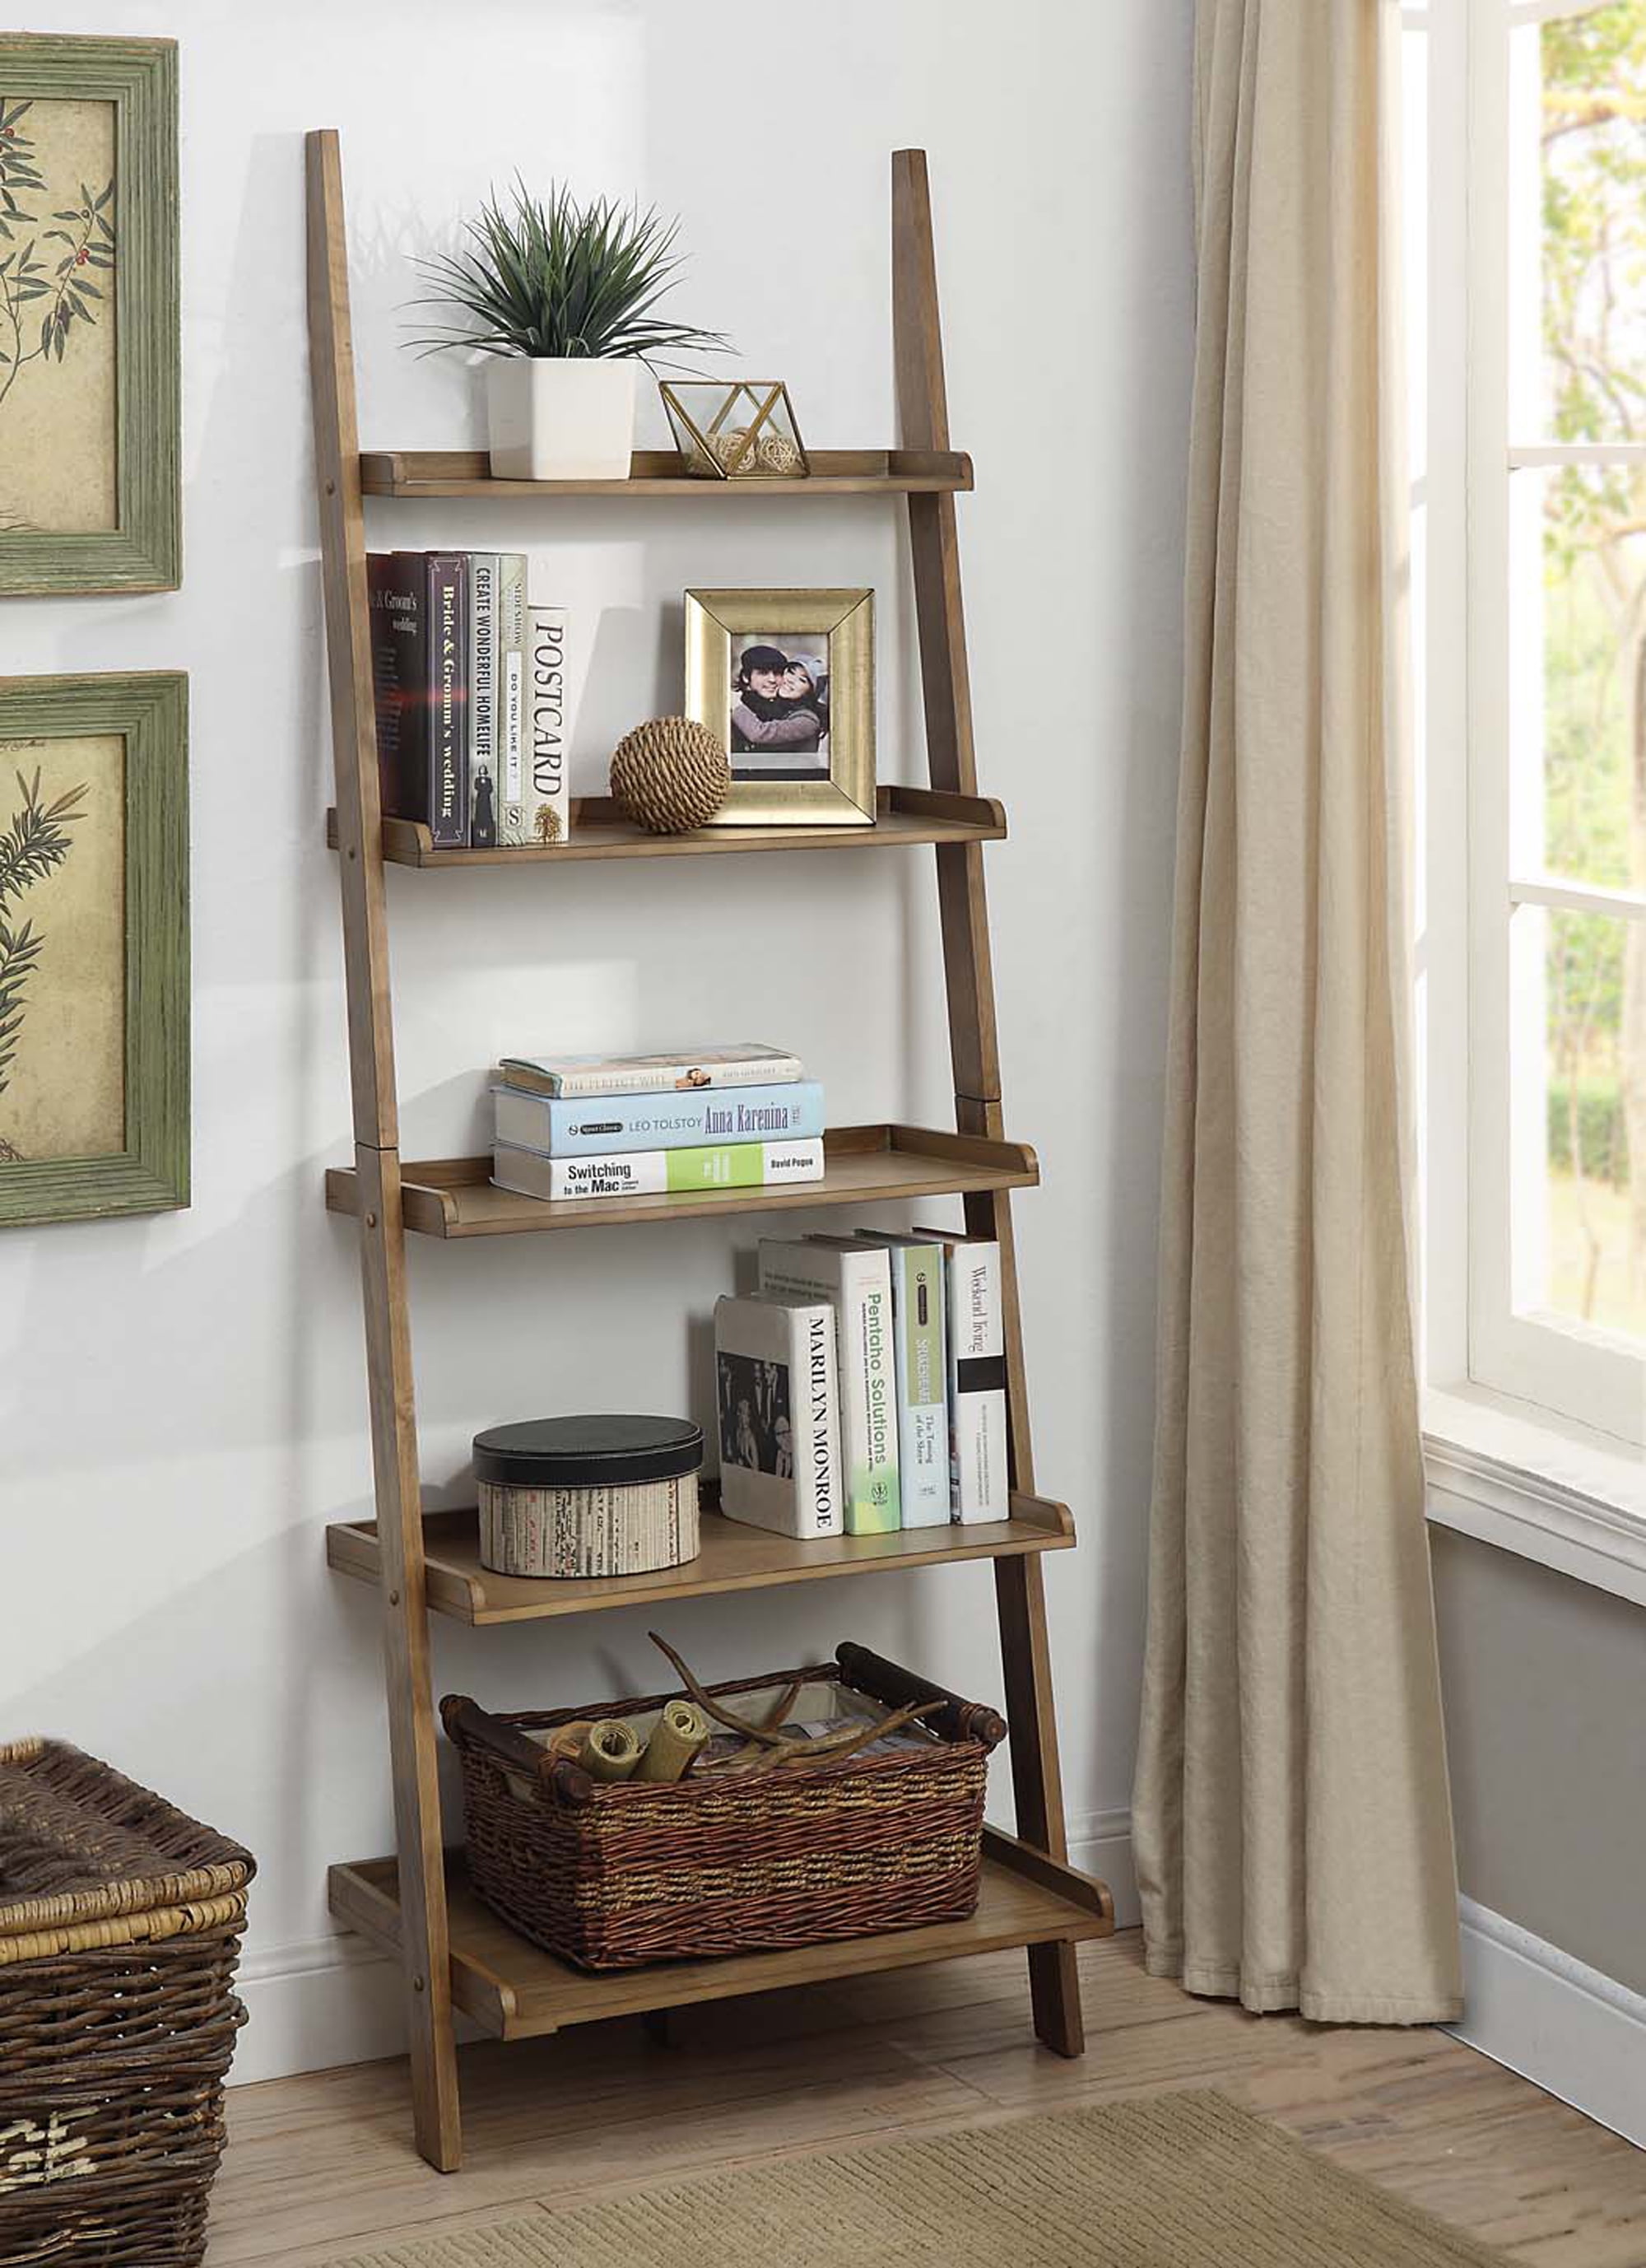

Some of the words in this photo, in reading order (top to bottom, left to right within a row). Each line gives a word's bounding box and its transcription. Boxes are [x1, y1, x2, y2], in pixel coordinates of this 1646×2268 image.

[443, 586, 454, 633] Bride
[477, 567, 491, 612] CREATE
[443, 639, 454, 655] &
[477, 617, 491, 692] WONDERFUL
[510, 673, 518, 692] DO
[533, 622, 564, 797] POSTCARD
[477, 696, 491, 757] HOMELIFE
[442, 746, 454, 818] wedding
[629, 1120, 651, 1133] LEO
[653, 1116, 702, 1131] TOLSTOY
[704, 1106, 733, 1134] Anna
[737, 1101, 788, 1132] Karenina
[564, 1185, 574, 1195] to
[574, 1184, 588, 1195] the
[590, 1178, 620, 1194] Mac
[568, 1162, 632, 1181] Switching
[867, 1293, 883, 1372] Pentaho
[810, 1318, 827, 1422] MARILYN
[871, 1378, 887, 1464] Solutions
[813, 1429, 832, 1529] MONROE
